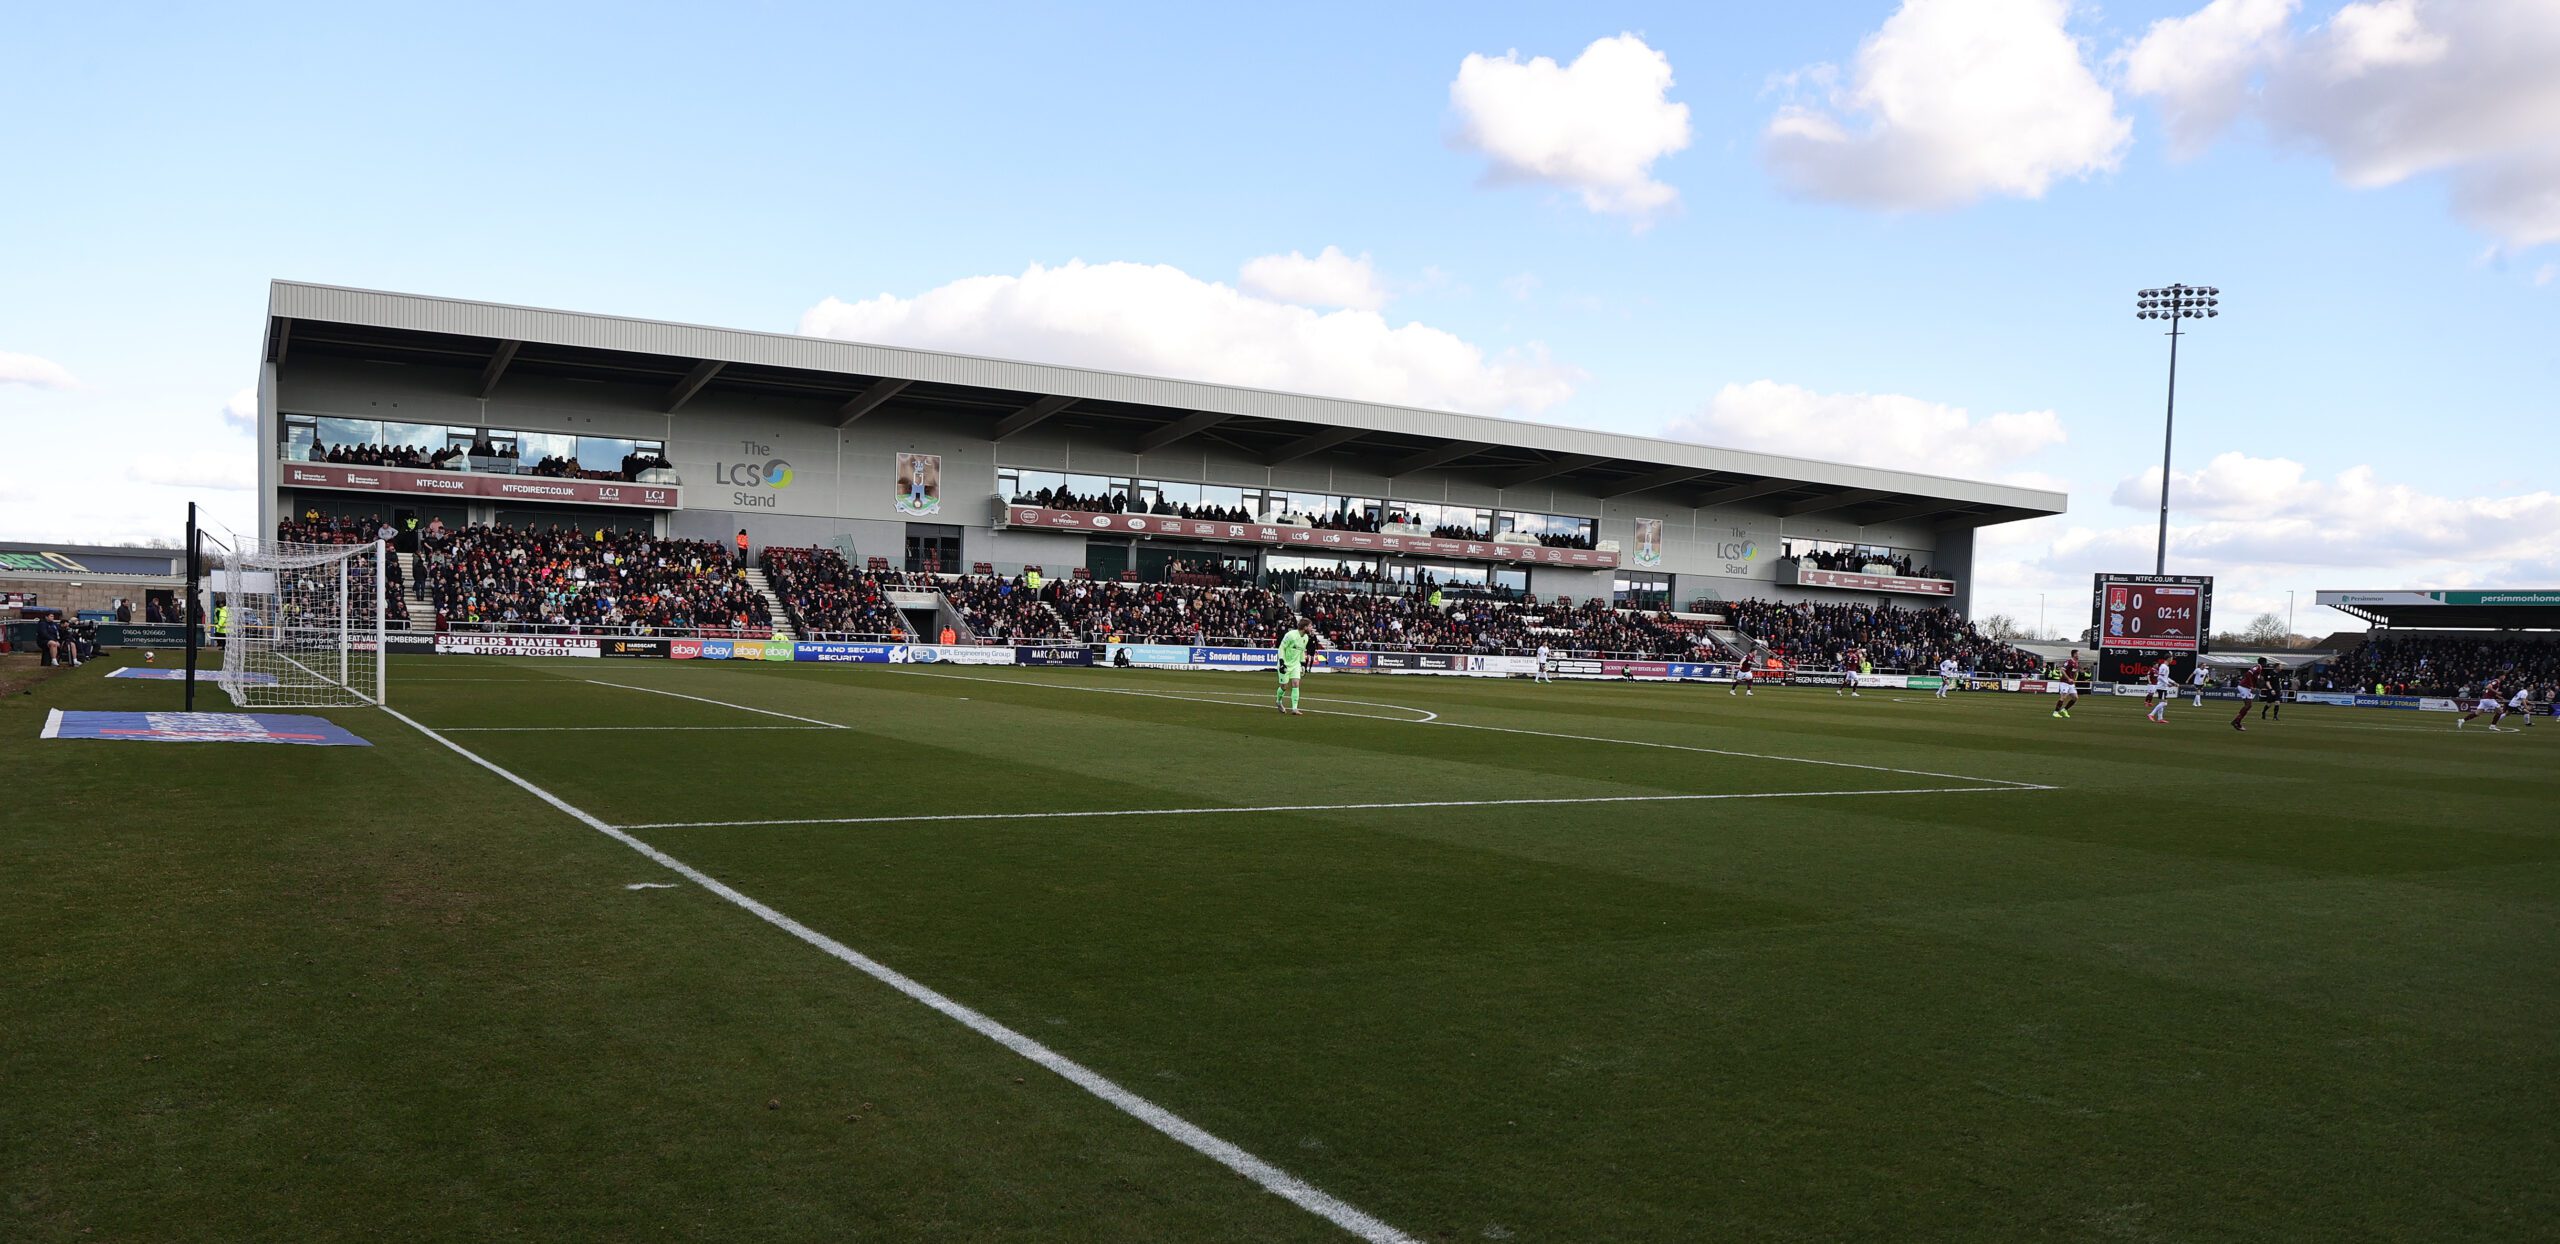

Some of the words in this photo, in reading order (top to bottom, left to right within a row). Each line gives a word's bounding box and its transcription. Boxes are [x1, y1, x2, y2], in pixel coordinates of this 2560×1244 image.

[741, 441, 770, 456] The
[716, 462, 760, 487] LCS
[416, 479, 464, 489] NTFC.CO.UK
[502, 484, 574, 496] NTFCDIRECT.CO.UK
[600, 488, 619, 496] LCJ
[645, 490, 664, 499] LCJ
[734, 492, 776, 507] Stand
[1731, 528, 1746, 538] The
[1717, 542, 1740, 560] LCS
[1726, 564, 1747, 574] Stand
[2132, 594, 2142, 609] 0
[2158, 607, 2190, 620] 02:14
[2132, 617, 2141, 633] 0
[385, 636, 434, 644] MEMBERSHIPS
[438, 636, 506, 646] SIXFIELDS
[510, 637, 560, 647] TRAVEL
[564, 638, 598, 648] CLUB
[474, 647, 516, 655] 01604
[522, 648, 570, 656] 706401
[672, 642, 700, 656] ebay
[704, 643, 730, 656] ebay
[735, 643, 762, 657] ebay
[766, 644, 792, 658] ebay
[915, 650, 934, 660] BPL
[954, 650, 990, 658] Engineering
[1032, 649, 1048, 659] MARC
[1060, 650, 1080, 660] DARCY
[1210, 652, 1240, 660] Snowdon
[1242, 653, 1265, 661] Homes
[1267, 654, 1278, 662] Ltd
[1335, 655, 1350, 665] sky
[1352, 655, 1366, 664] bet
